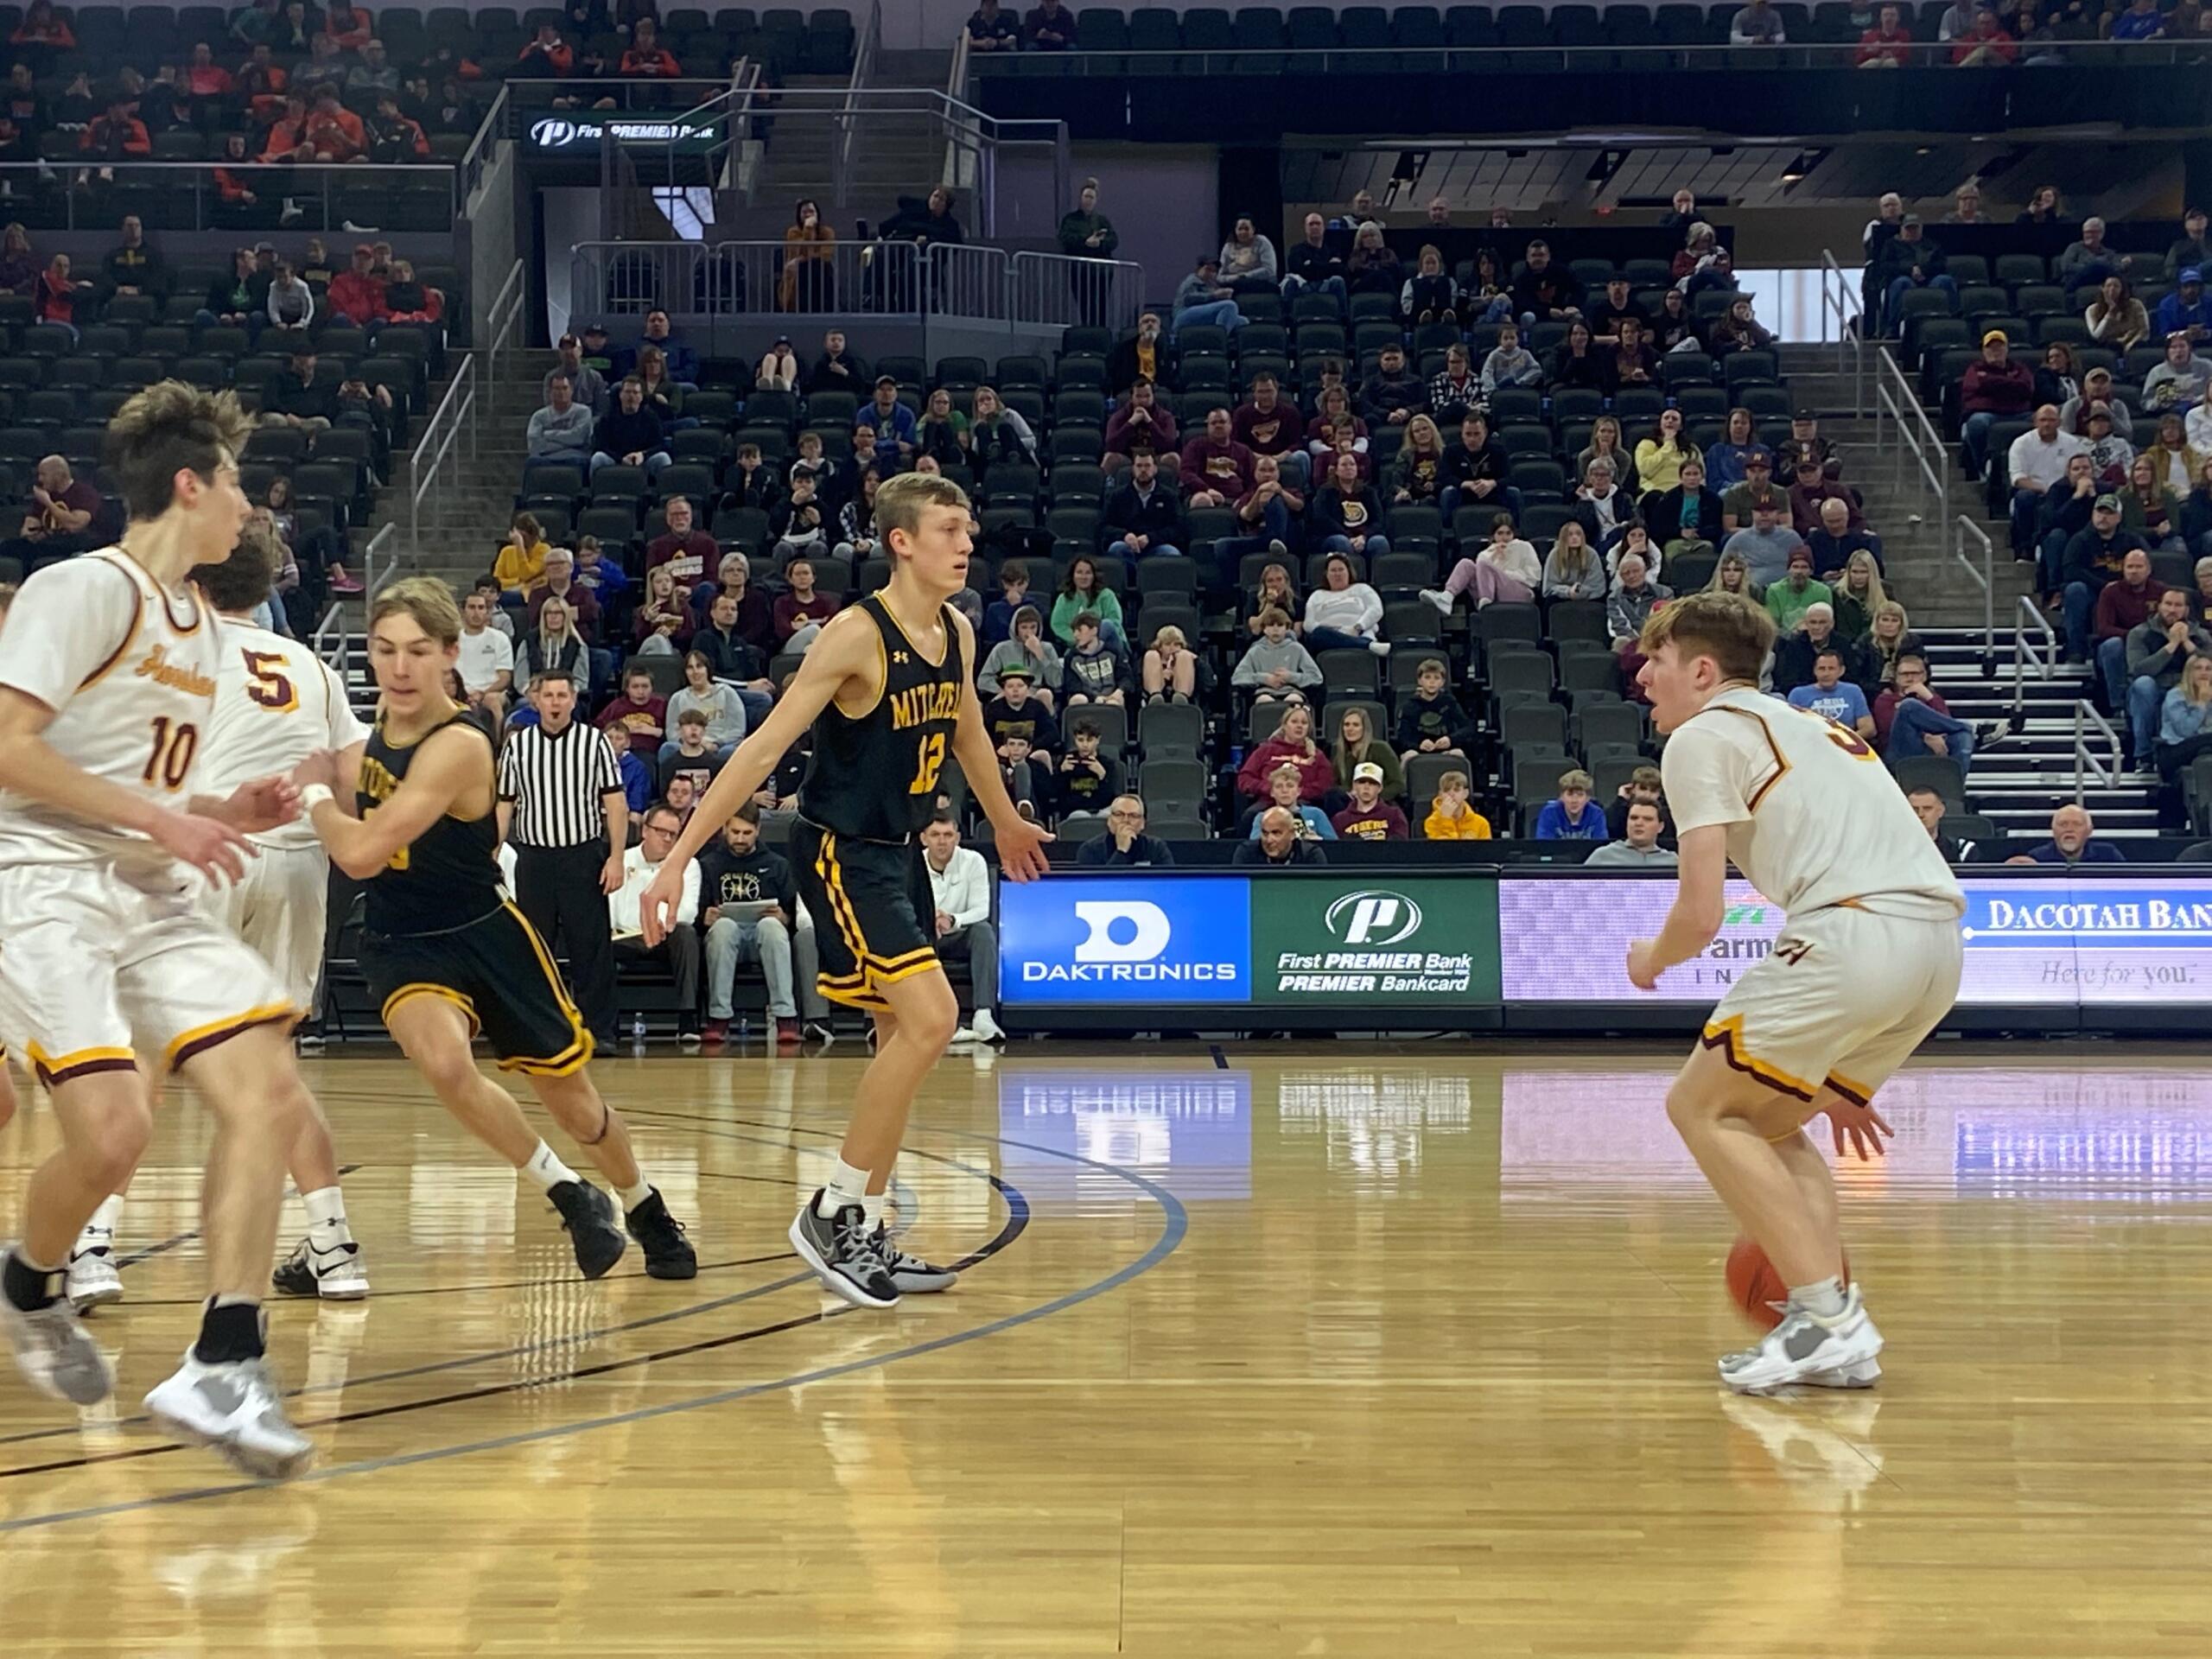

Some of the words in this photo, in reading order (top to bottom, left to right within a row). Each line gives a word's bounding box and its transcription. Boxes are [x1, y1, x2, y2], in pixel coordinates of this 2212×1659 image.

[576, 124, 603, 138] Firs
[240, 647, 301, 714] 5
[143, 715, 198, 792] 10
[909, 732, 946, 794] 12
[1988, 899, 2142, 929] DACOTAH
[1022, 961, 1236, 982] DAKTRONICS
[1277, 952, 1323, 969] First
[1324, 952, 1423, 969] PREMIER
[1425, 952, 1473, 969] Bank
[2041, 960, 2097, 984] Here
[2098, 960, 2137, 990] for
[1277, 975, 1376, 992] PREMIER
[1380, 975, 1470, 992] Bankcard
